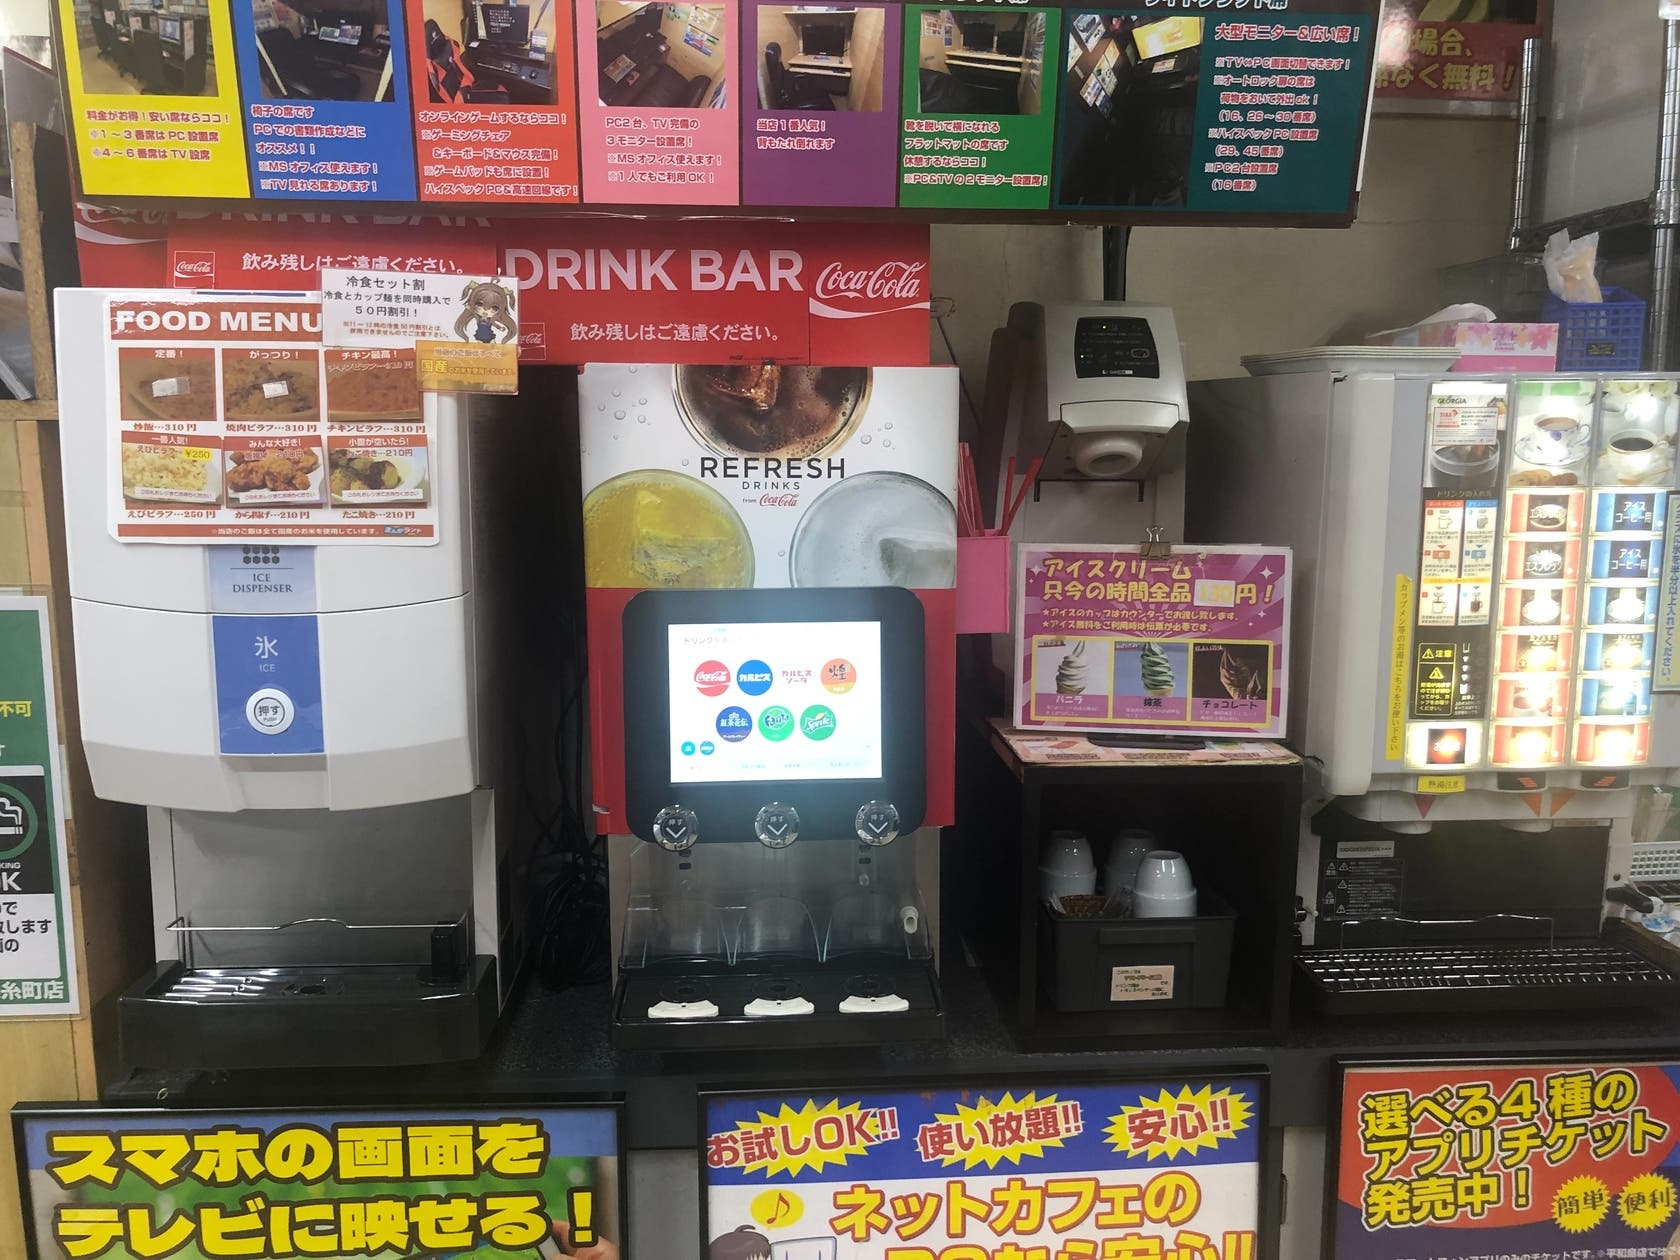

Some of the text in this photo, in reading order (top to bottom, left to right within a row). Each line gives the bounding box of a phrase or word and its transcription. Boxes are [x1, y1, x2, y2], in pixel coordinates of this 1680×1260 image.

[251, 105, 314, 119] 椅子の席です
[419, 112, 567, 125] オンラインゲームするならココ！
[253, 124, 367, 138] PCでの書類作成などに
[421, 130, 510, 142] ※ゲーミングチェア
[757, 120, 826, 132] 当店1番人気！
[757, 137, 835, 150] 背もたれ倒れます
[904, 139, 1008, 151] フラットマットの席です
[904, 155, 987, 168] 休憩するならココ！
[242, 252, 467, 275] 飲み残しはご遠慮ください。
[504, 249, 804, 291] DRINK BAR
[346, 276, 425, 291] 冷食セット割
[815, 260, 927, 299] Coca-Cola
[115, 310, 322, 332] FOOD MENU
[570, 322, 780, 342] 飲み残しはご遠慮ください。
[700, 457, 845, 479] REFRESH
[742, 482, 801, 490] DRINKS
[759, 494, 799, 507] Coca-Cola
[253, 573, 271, 582] ICE
[1044, 558, 1192, 580] アイスクリーム
[233, 584, 293, 593] DISPENSER
[254, 636, 279, 659] 氷
[260, 664, 275, 672] ICE
[258, 705, 280, 716] 押す
[1202, 700, 1258, 711] チョコレート
[0, 980, 64, 1001] 糸町店
[1361, 1070, 1639, 1139] 選べる4種の
[918, 1102, 1083, 1161] 使い放題!!
[1127, 1097, 1232, 1149] 安心!!
[707, 1108, 900, 1167] お試しOK!!
[1363, 1109, 1668, 1182] アプリチケット
[46, 1119, 550, 1187] スマホの画面を
[830, 1171, 1201, 1242] ネットカフェの
[1363, 1167, 1532, 1231] 発売中！
[1556, 1190, 1605, 1214] 簡単
[1624, 1188, 1671, 1213] 便利
[54, 1183, 600, 1259] テレビに映せる！
